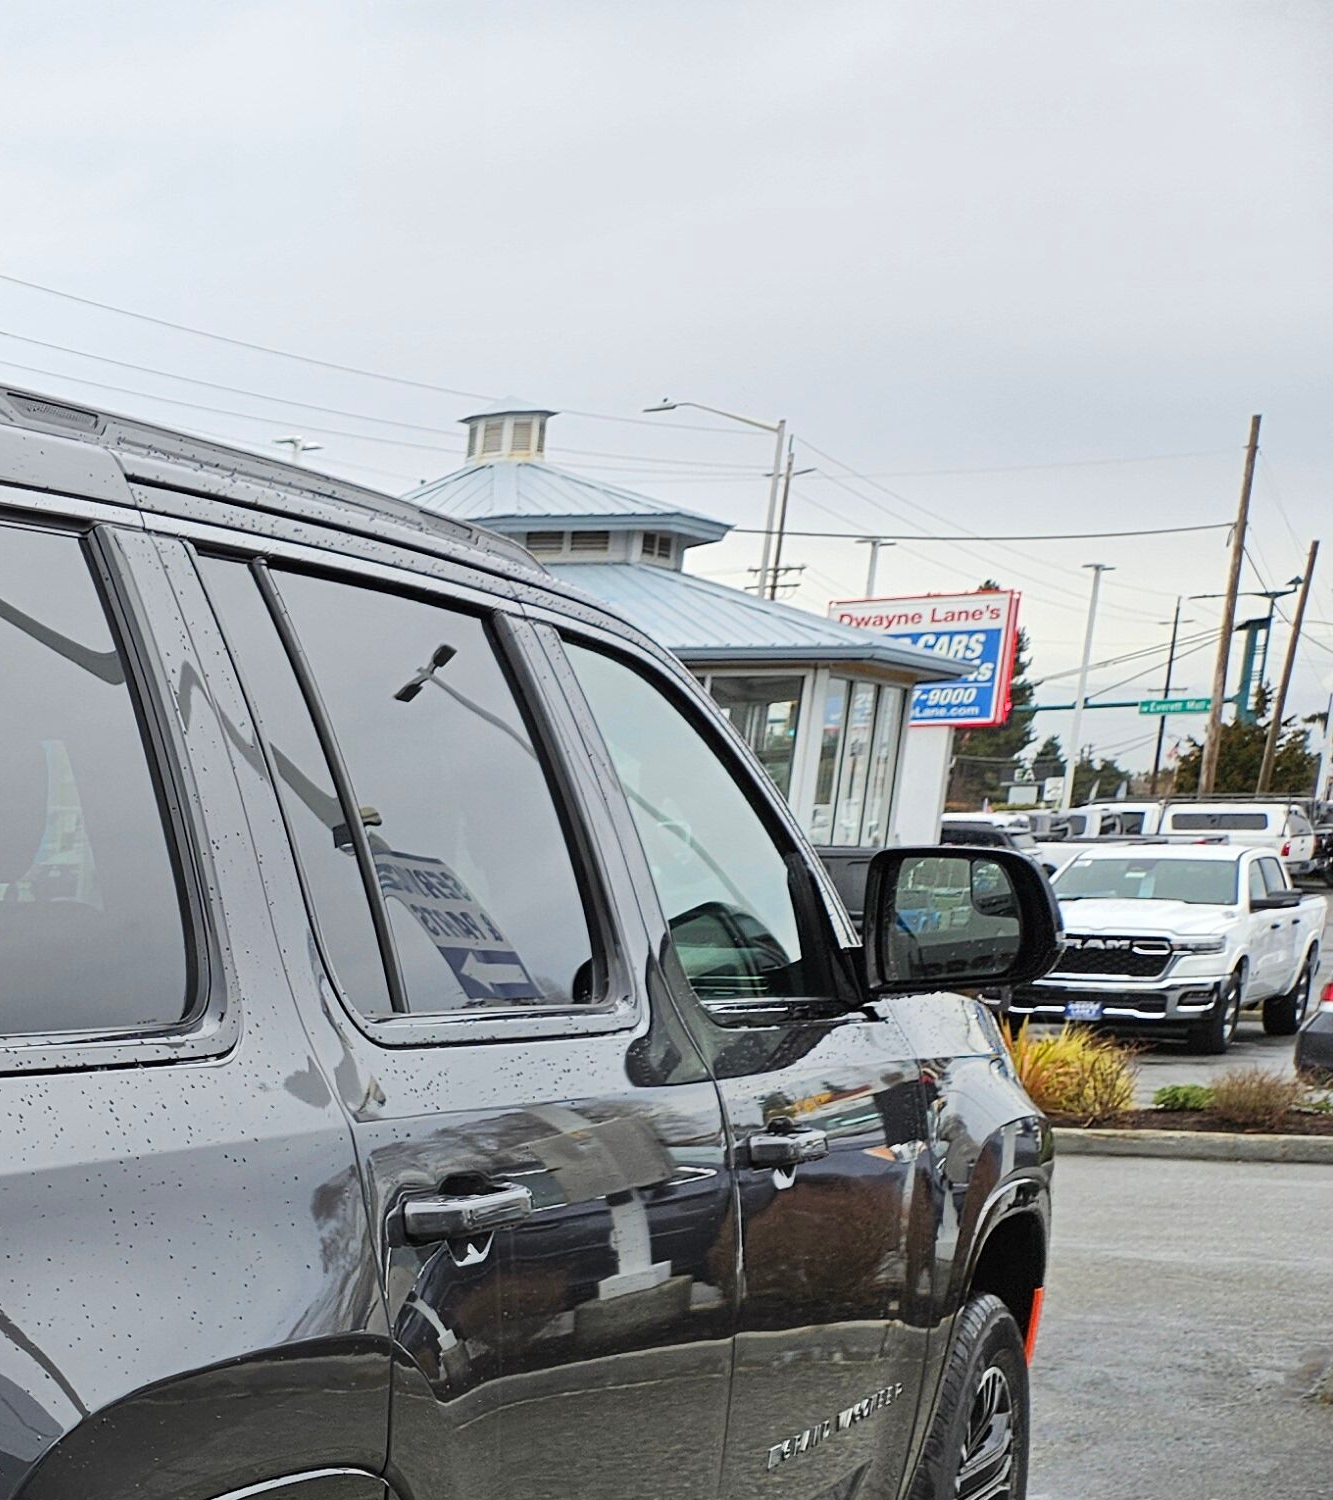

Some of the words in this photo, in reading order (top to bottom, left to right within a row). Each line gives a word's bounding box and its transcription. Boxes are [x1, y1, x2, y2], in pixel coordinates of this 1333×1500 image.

[839, 610, 922, 630] Dwayne
[930, 604, 1001, 624] Lane's
[916, 632, 987, 661] CARS
